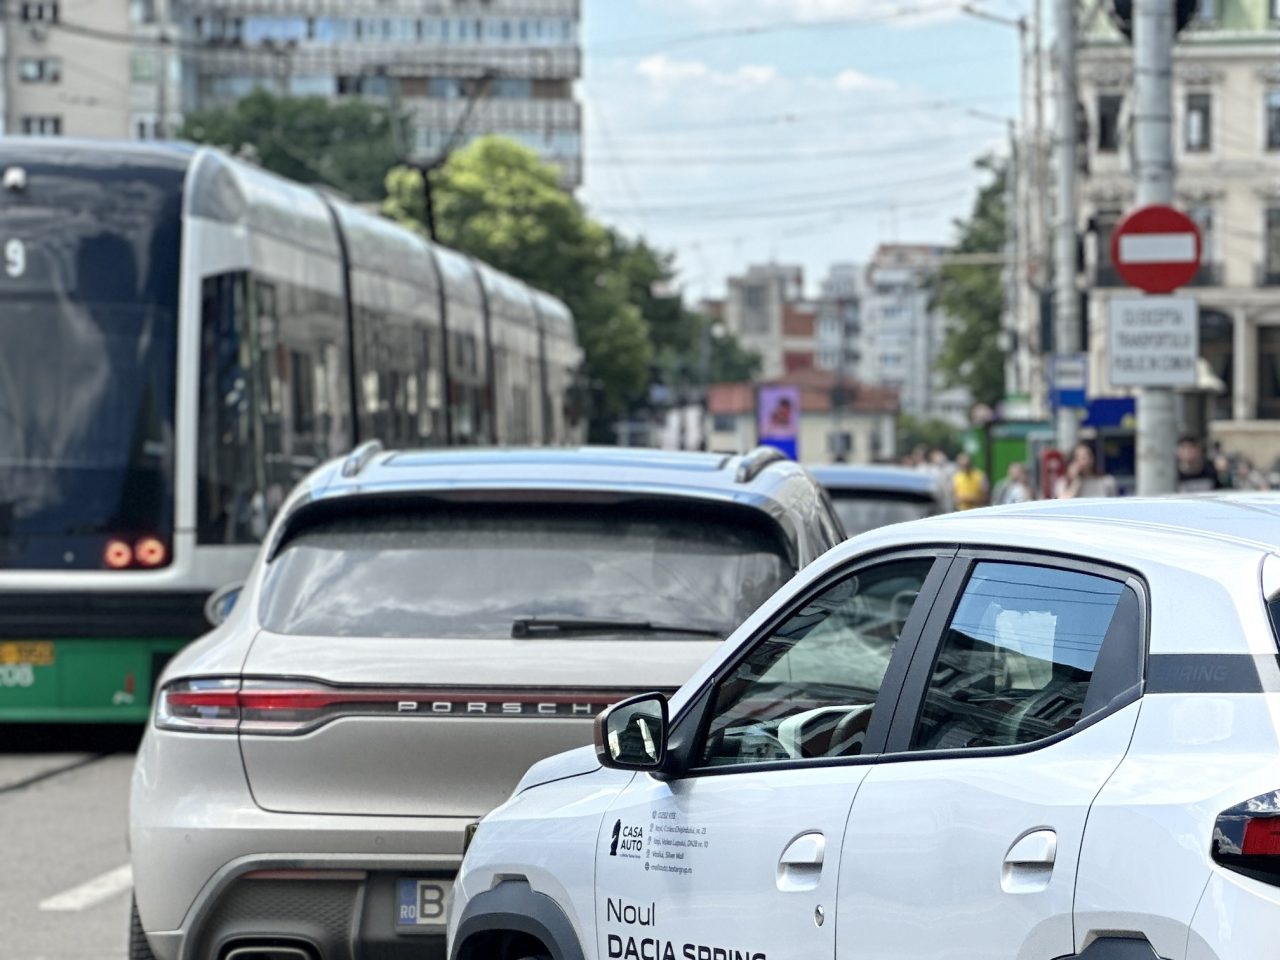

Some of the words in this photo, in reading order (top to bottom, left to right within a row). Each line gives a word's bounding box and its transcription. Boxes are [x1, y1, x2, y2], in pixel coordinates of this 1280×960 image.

[5, 238, 26, 278] 9
[398, 701, 612, 714] PORSCH
[622, 826, 643, 838] CASA
[620, 839, 643, 851] AUTO
[419, 884, 445, 918] B
[400, 905, 416, 919] RO
[607, 897, 655, 927] Noul
